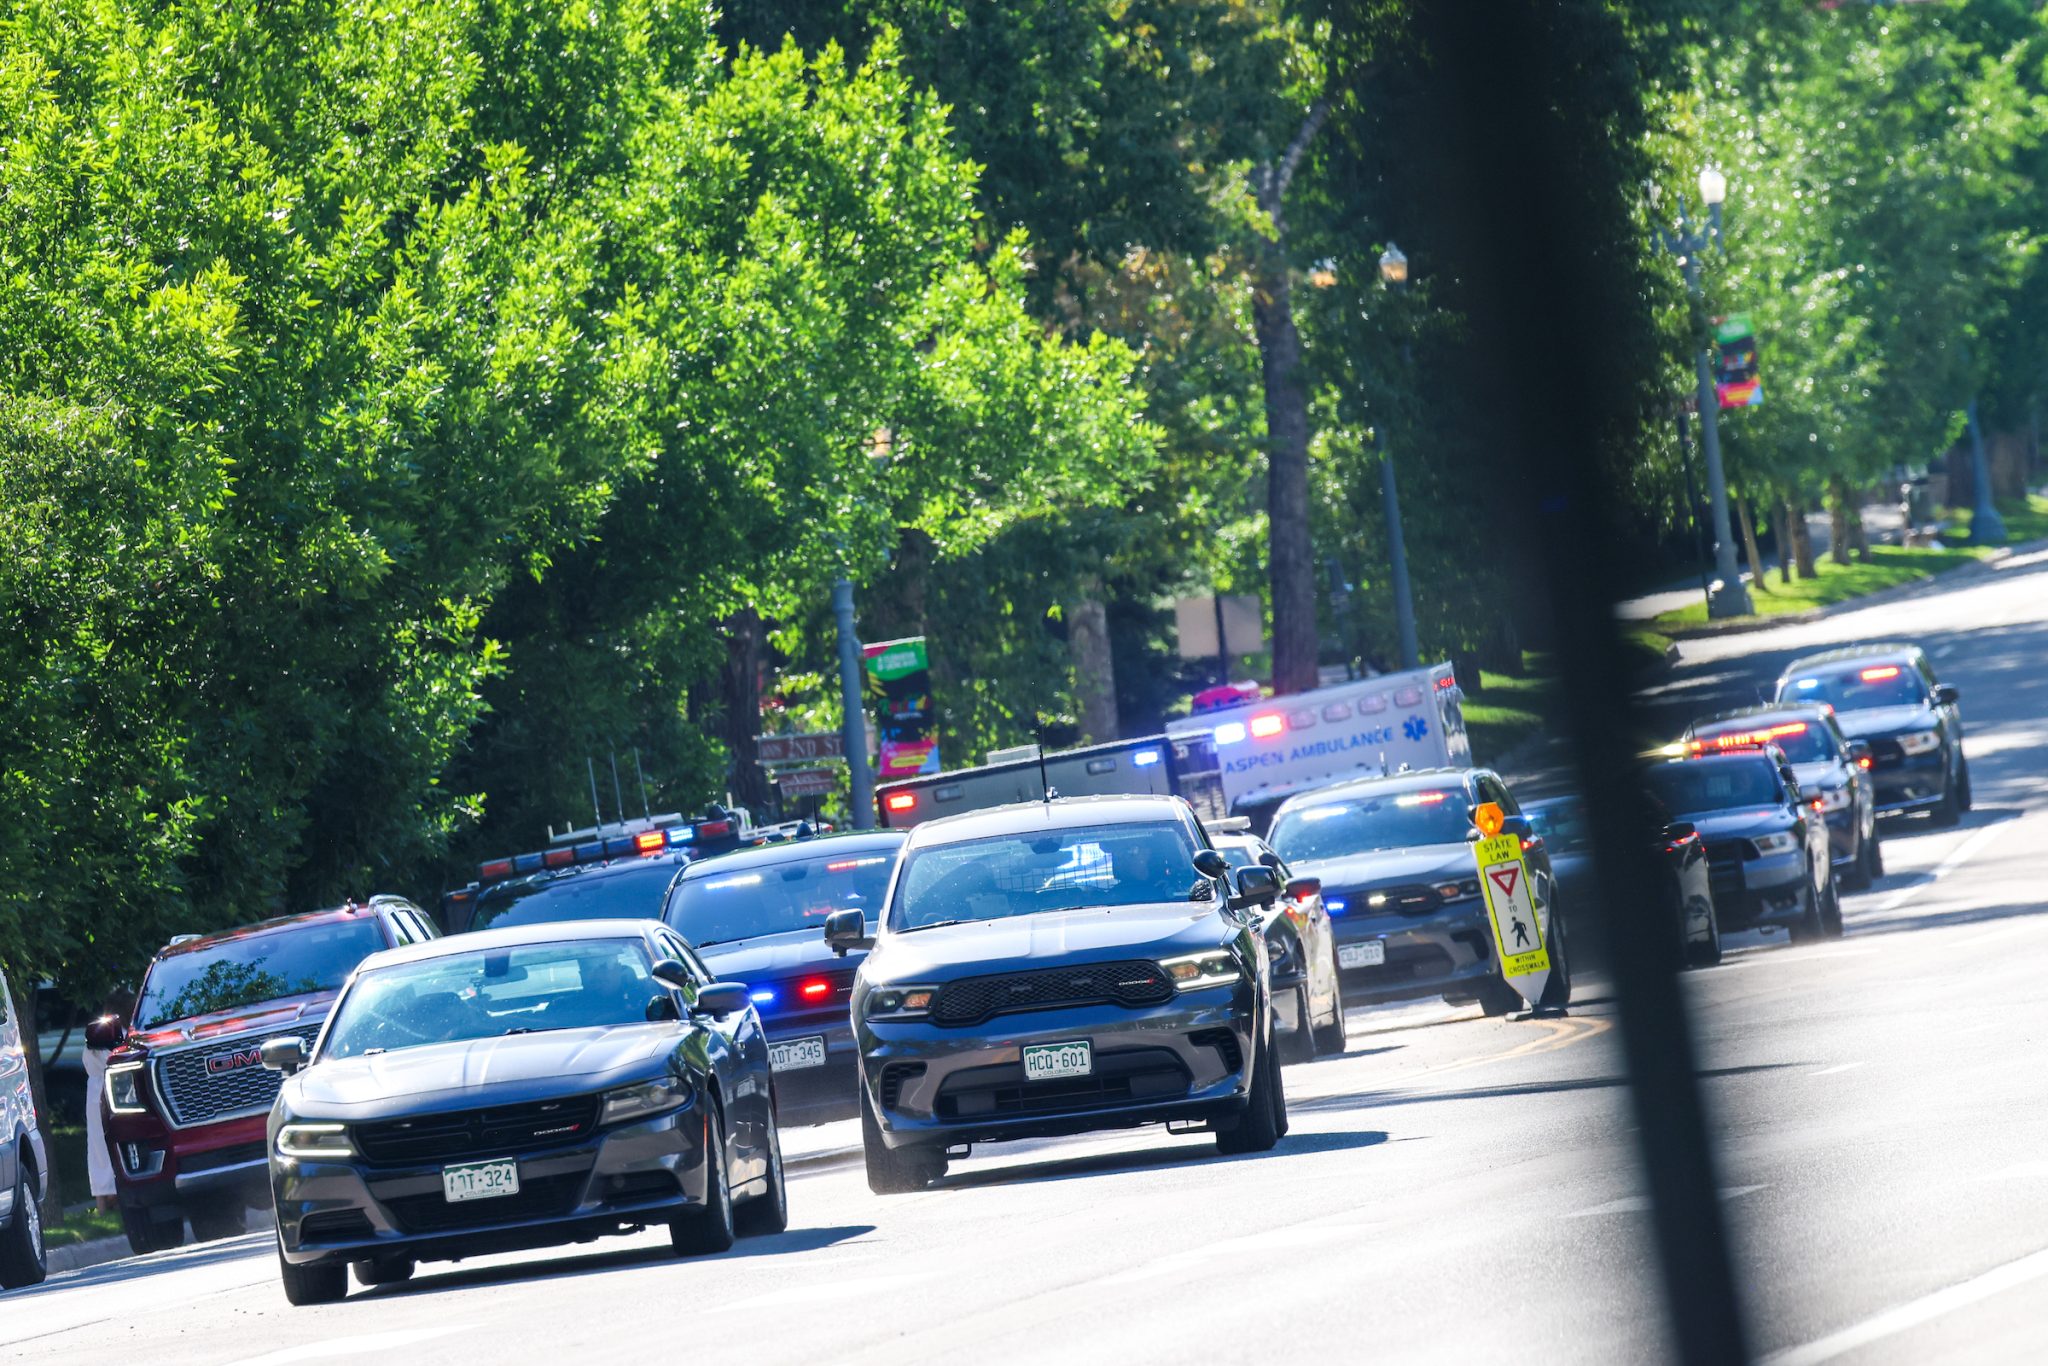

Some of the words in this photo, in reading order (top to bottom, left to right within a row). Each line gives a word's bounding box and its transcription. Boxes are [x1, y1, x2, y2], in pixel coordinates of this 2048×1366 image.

[1225, 752, 1284, 774] ASPEN
[1290, 726, 1394, 761] AMBULANCE
[1483, 838, 1512, 853] STATE
[1490, 850, 1510, 862] LAW
[1508, 904, 1518, 913] TO
[1514, 954, 1536, 964] WITHIN
[1509, 961, 1546, 974] CROSSWALK
[209, 1049, 262, 1073] GM
